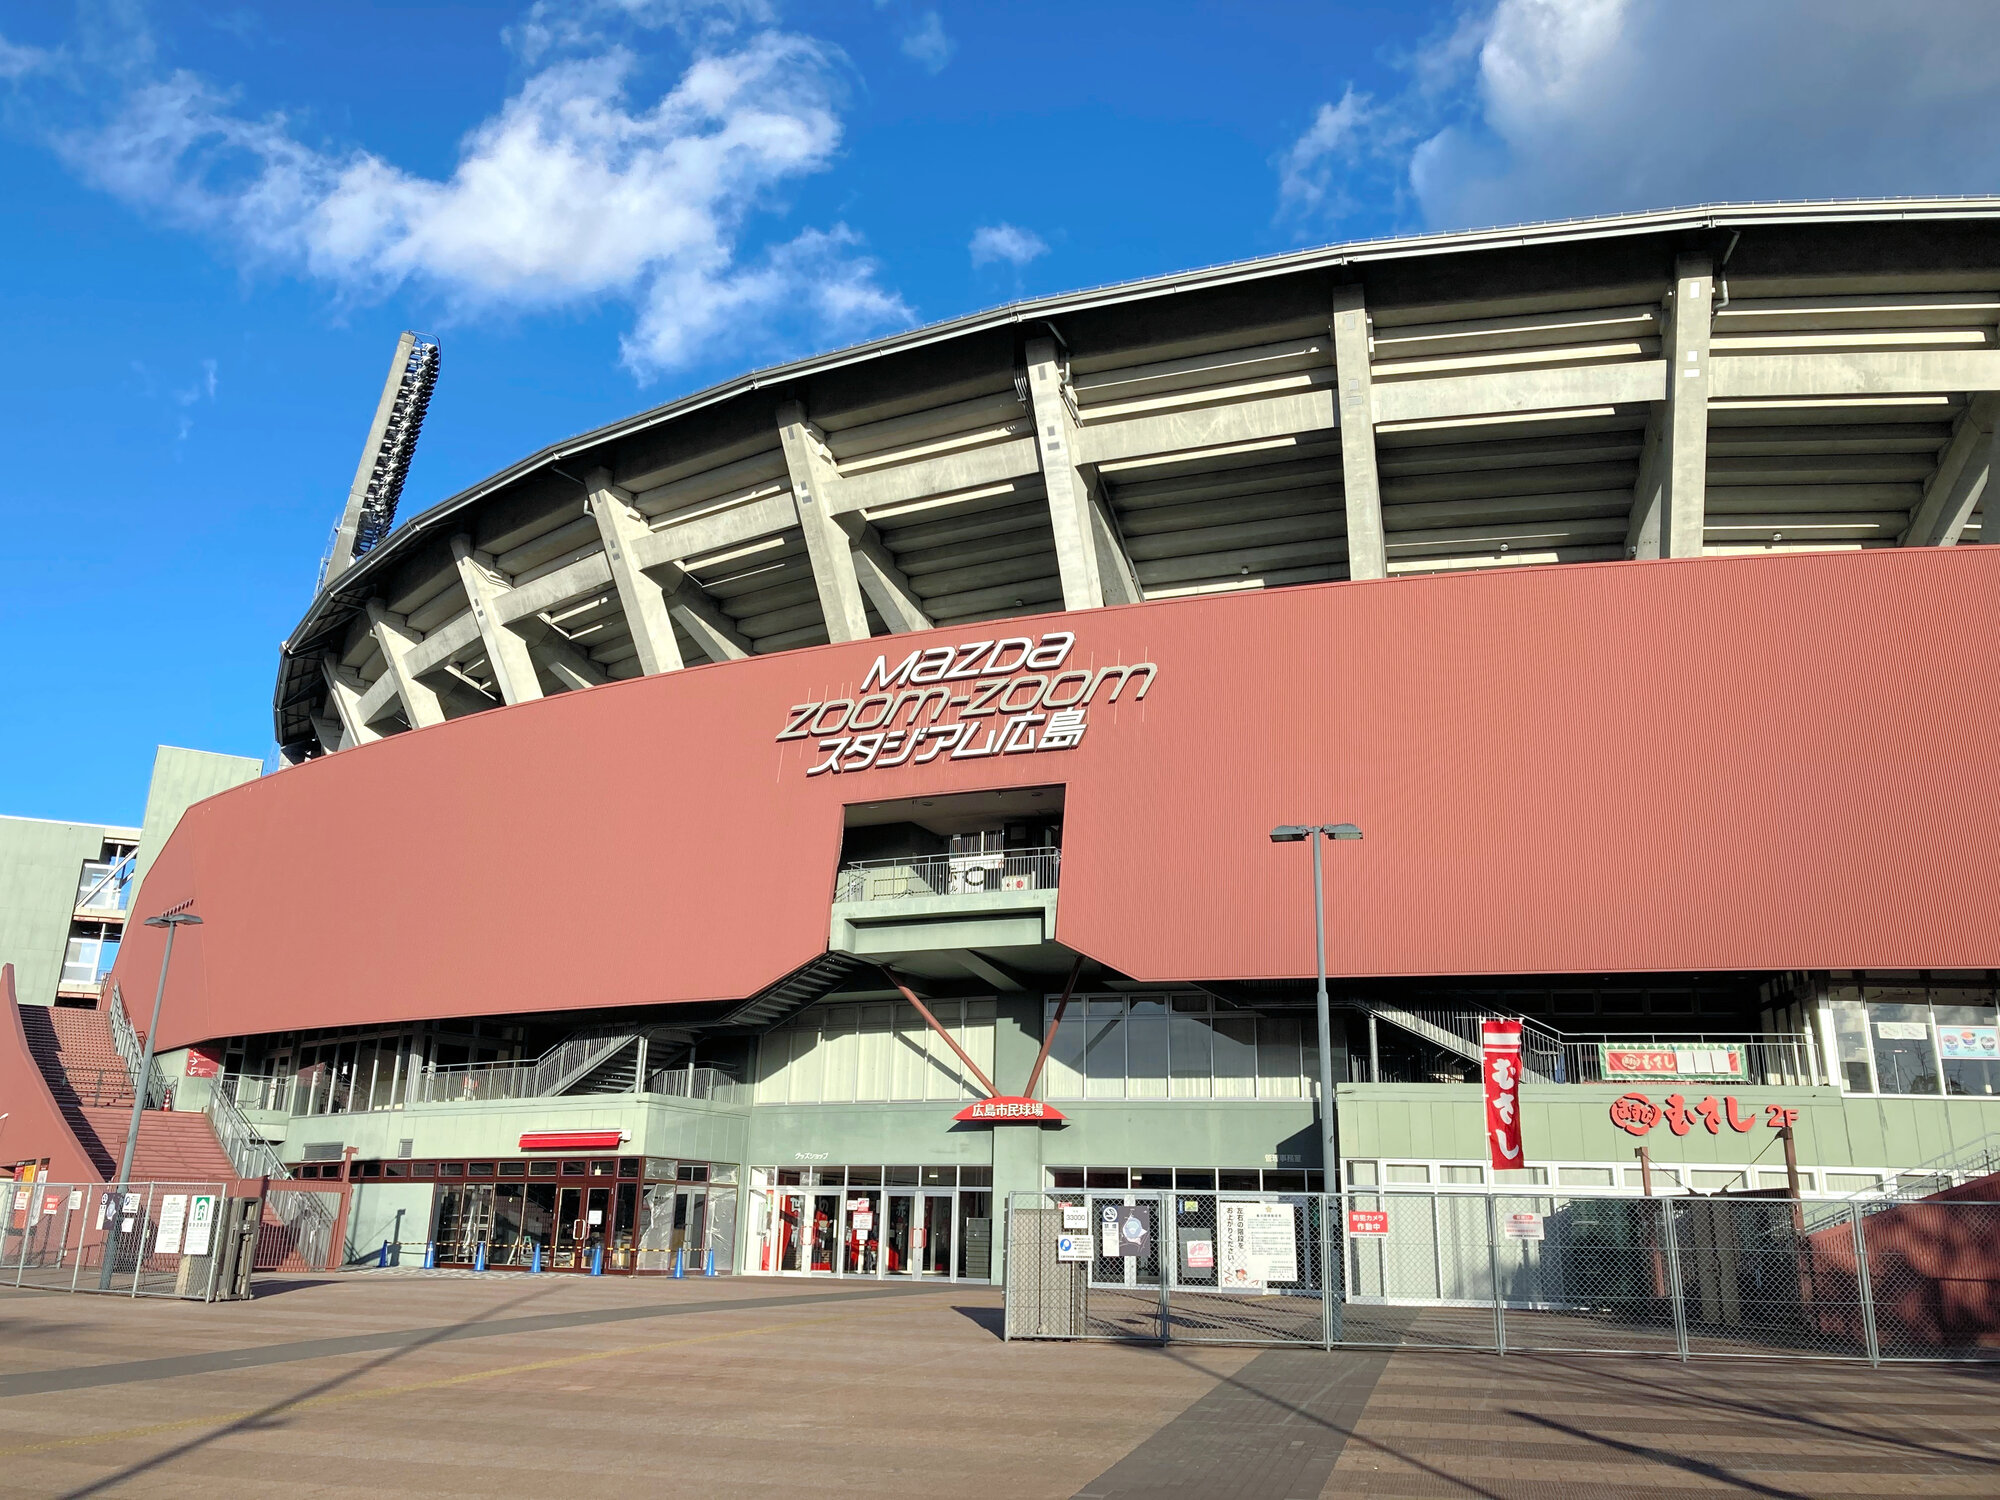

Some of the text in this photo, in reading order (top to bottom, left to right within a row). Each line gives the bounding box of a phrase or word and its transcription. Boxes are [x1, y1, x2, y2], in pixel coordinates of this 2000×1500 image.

[806, 707, 1089, 776] スタジアム広島
[1641, 1054, 1675, 1070] むさし
[971, 1103, 1044, 1117] 広島市民球場
[1491, 1058, 1519, 1160] むさし
[1663, 1092, 1756, 1136] むさし
[1765, 1104, 1799, 1127] 2F
[1226, 1207, 1235, 1265] お上がりください。
[1236, 1207, 1244, 1250] 左右の階段を
[1352, 1214, 1384, 1222] 防犯カメラ
[1357, 1222, 1381, 1231] 作動中
